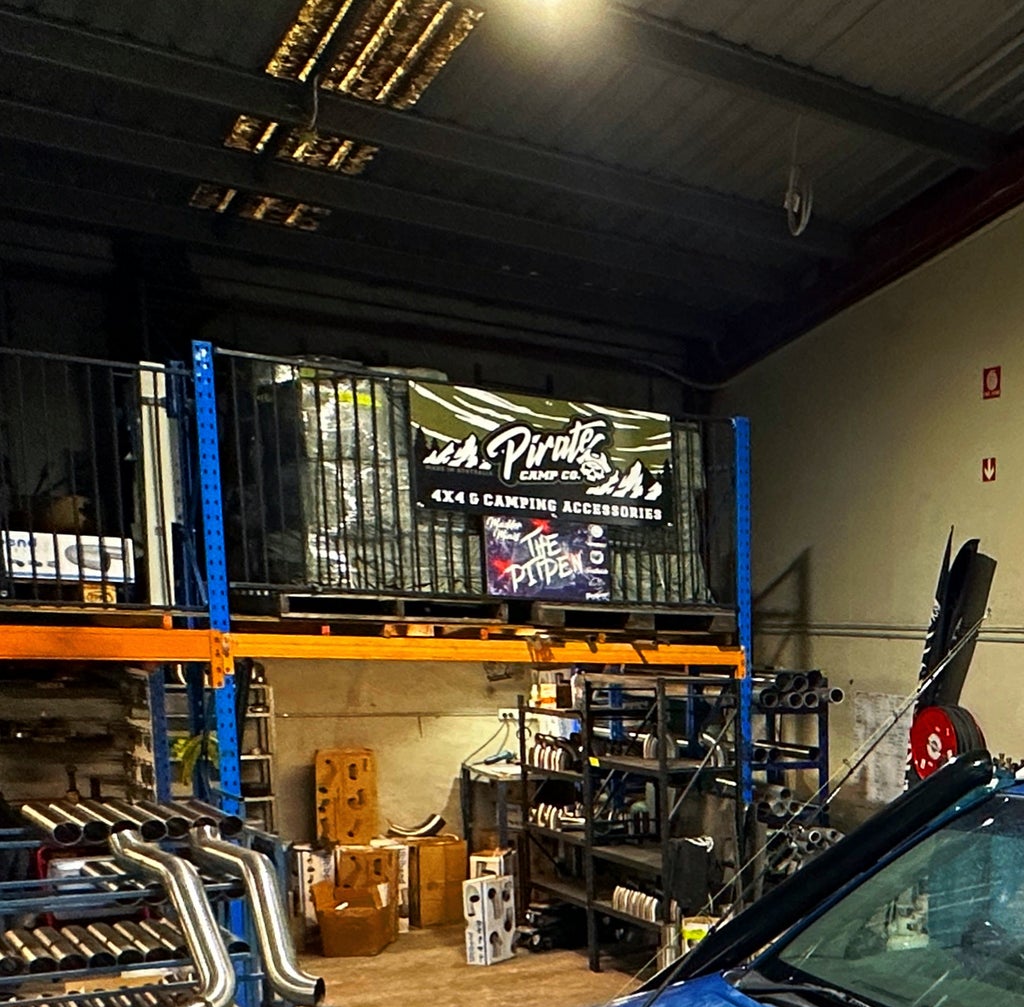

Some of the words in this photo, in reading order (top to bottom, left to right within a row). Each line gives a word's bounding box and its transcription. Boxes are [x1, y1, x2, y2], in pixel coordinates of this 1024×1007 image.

[519, 470, 558, 481] CAMP
[561, 470, 581, 480] CO.
[431, 489, 465, 504] 4X4
[483, 493, 557, 512] CAMPING
[562, 500, 662, 520] ACCESSORIES
[520, 525, 561, 558] THE
